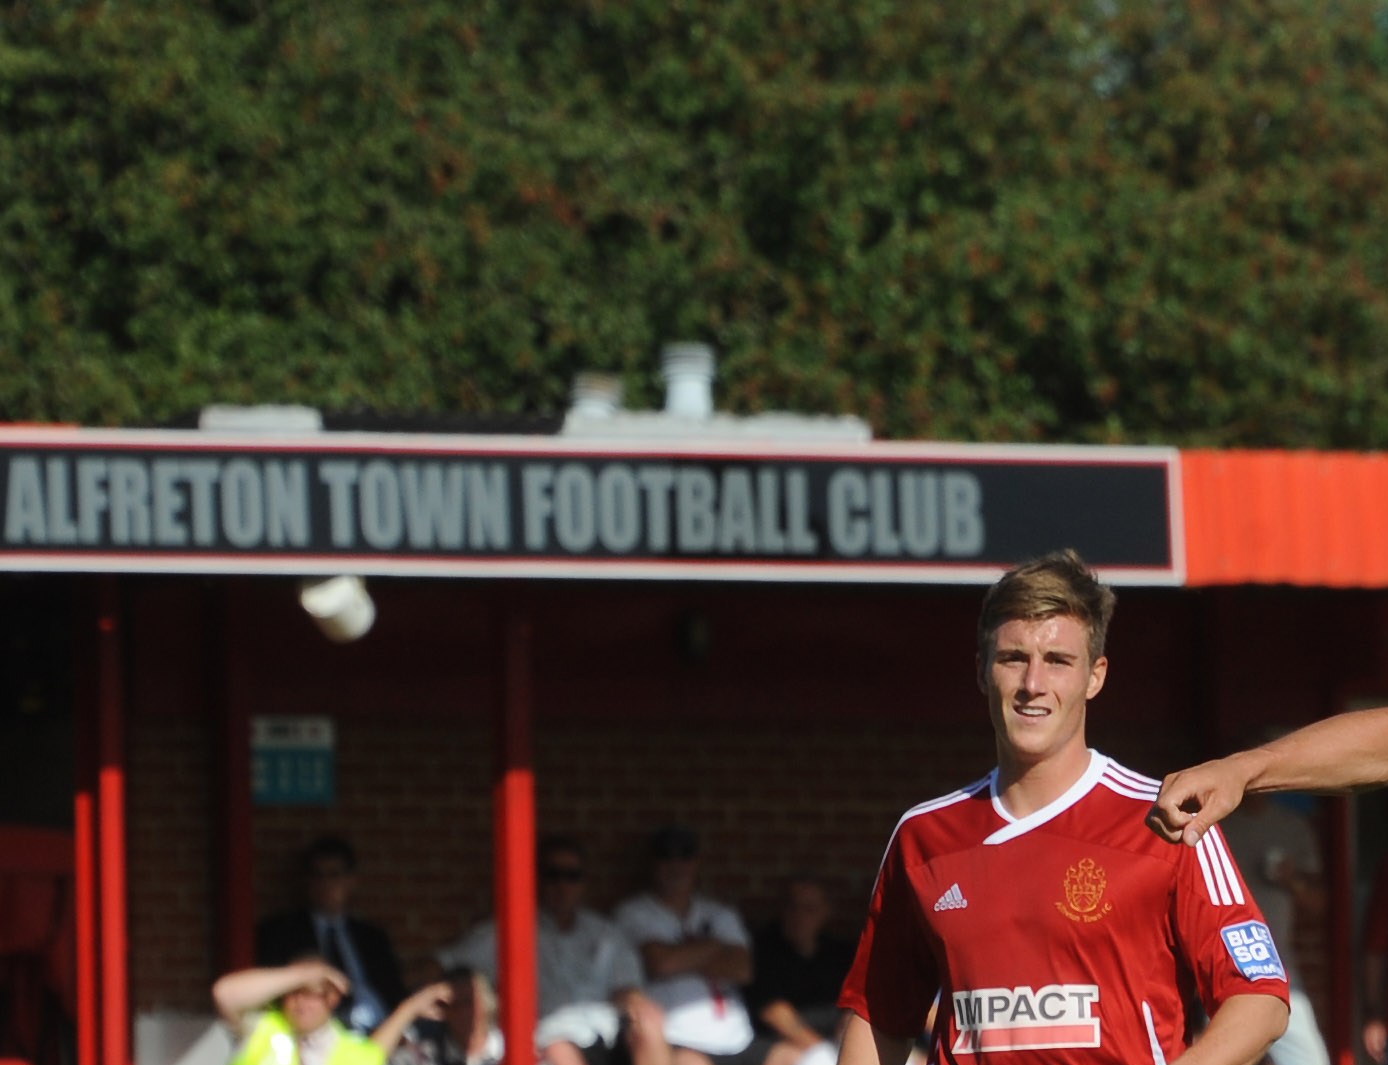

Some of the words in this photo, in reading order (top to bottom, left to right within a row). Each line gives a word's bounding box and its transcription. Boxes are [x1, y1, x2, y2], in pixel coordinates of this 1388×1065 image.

[4, 455, 310, 548] ALFRETON
[319, 460, 512, 550] TOWN
[522, 463, 818, 554] FOOTBALL
[827, 468, 985, 557] CLUB
[1226, 925, 1271, 948] BLUE
[1233, 942, 1271, 963] SQ
[955, 991, 1094, 1026] IMPACT
